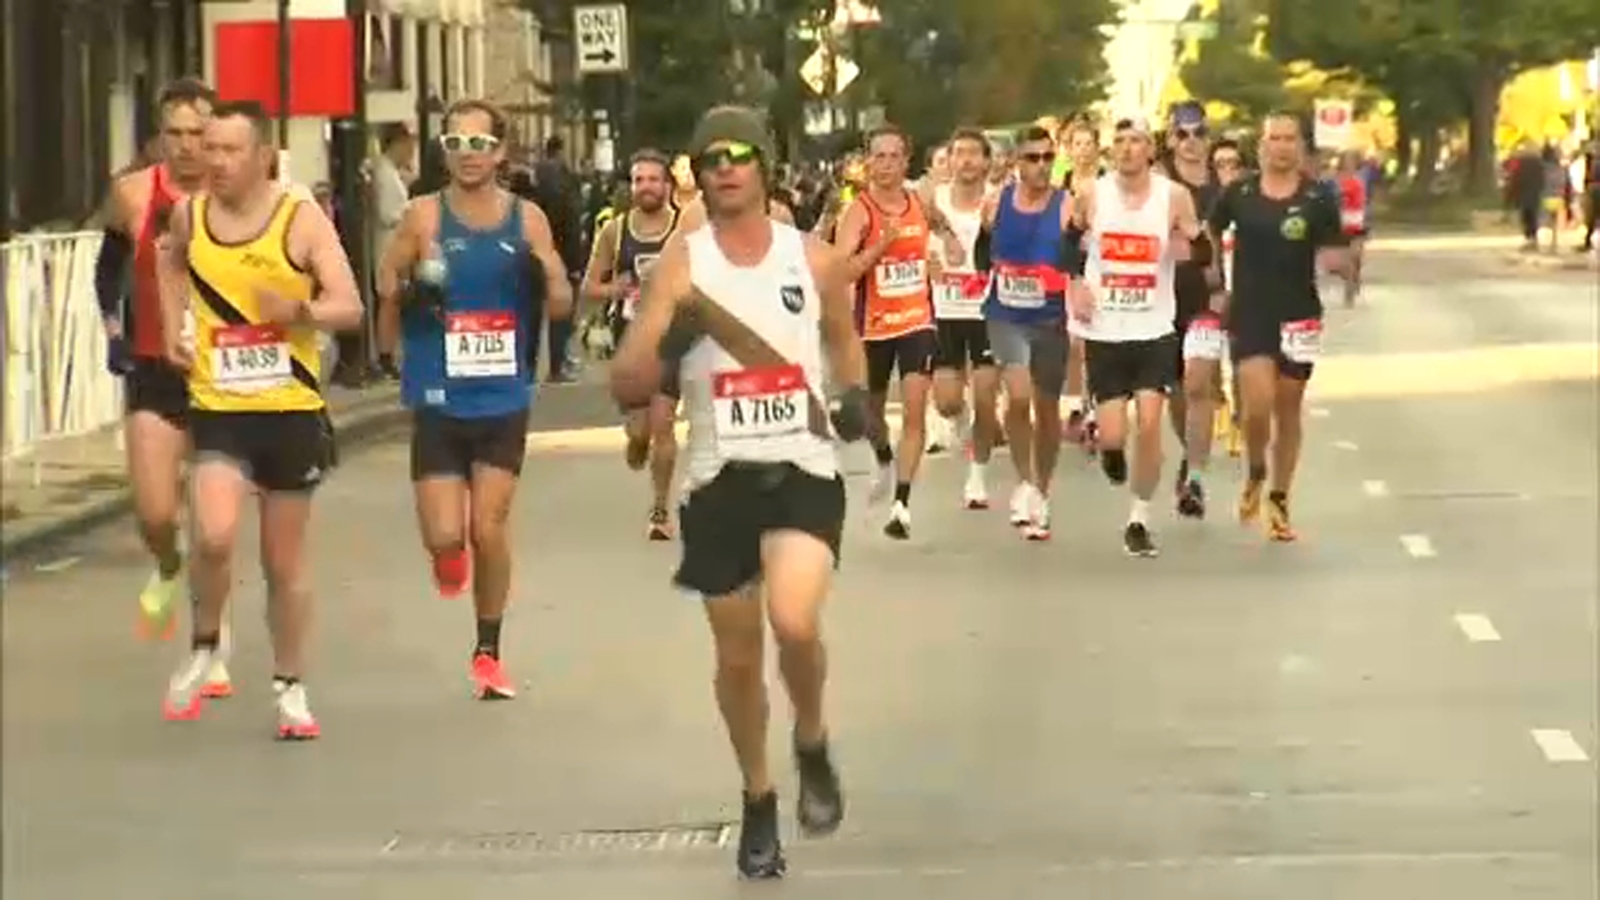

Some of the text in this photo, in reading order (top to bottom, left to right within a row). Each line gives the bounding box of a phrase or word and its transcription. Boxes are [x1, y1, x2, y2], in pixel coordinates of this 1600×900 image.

[580, 13, 616, 29] ONE
[582, 30, 616, 46] WAY
[459, 334, 470, 355] A
[731, 394, 796, 426] A 7165
